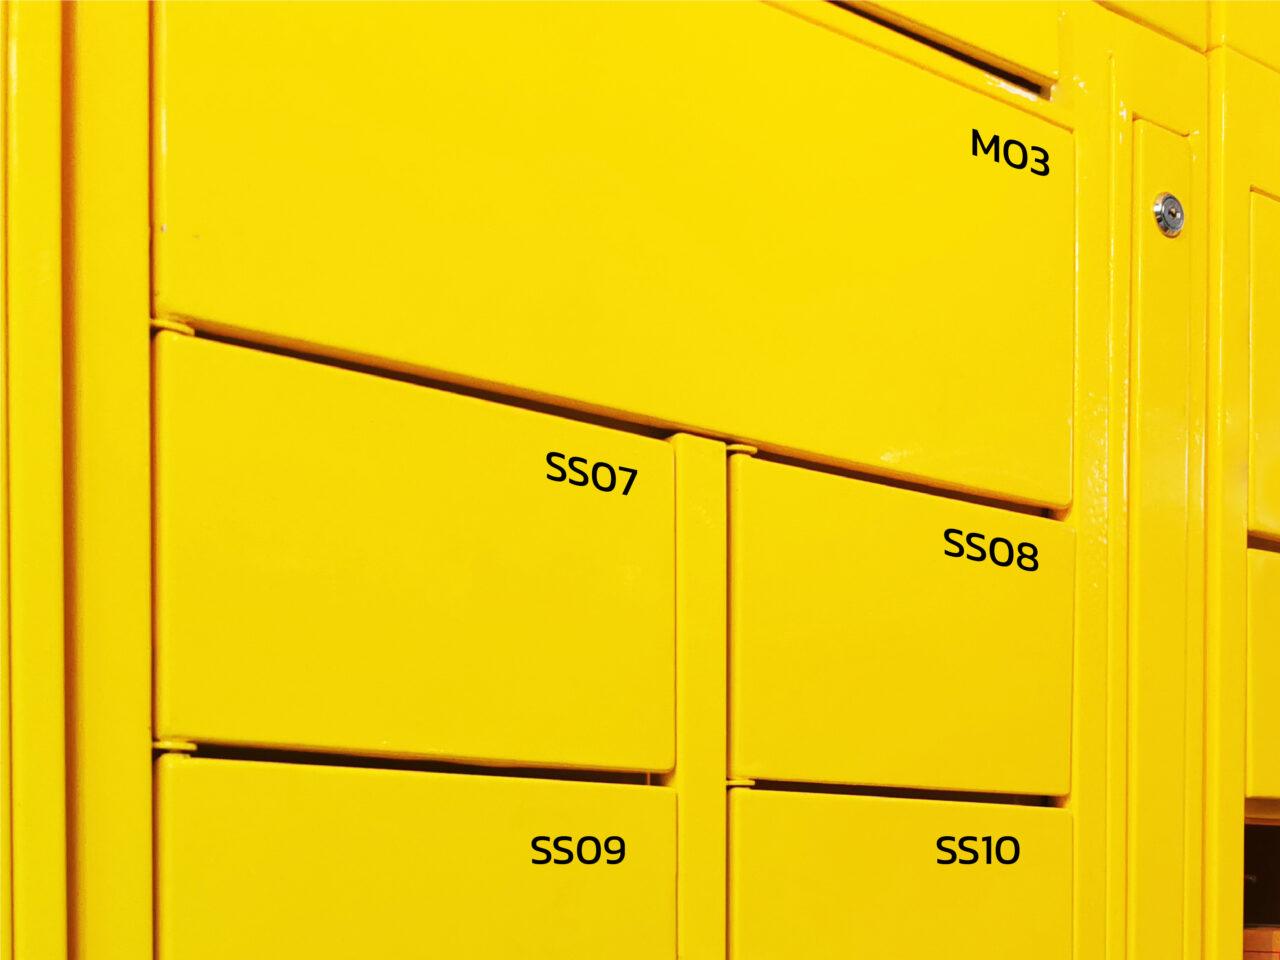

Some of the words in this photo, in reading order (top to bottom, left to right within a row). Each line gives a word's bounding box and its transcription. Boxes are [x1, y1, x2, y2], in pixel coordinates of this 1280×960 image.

[972, 128, 1050, 177] M03
[546, 451, 638, 496] SS07
[943, 528, 1039, 572] SS08
[531, 835, 626, 865] SS09
[936, 835, 1020, 865] SS10
